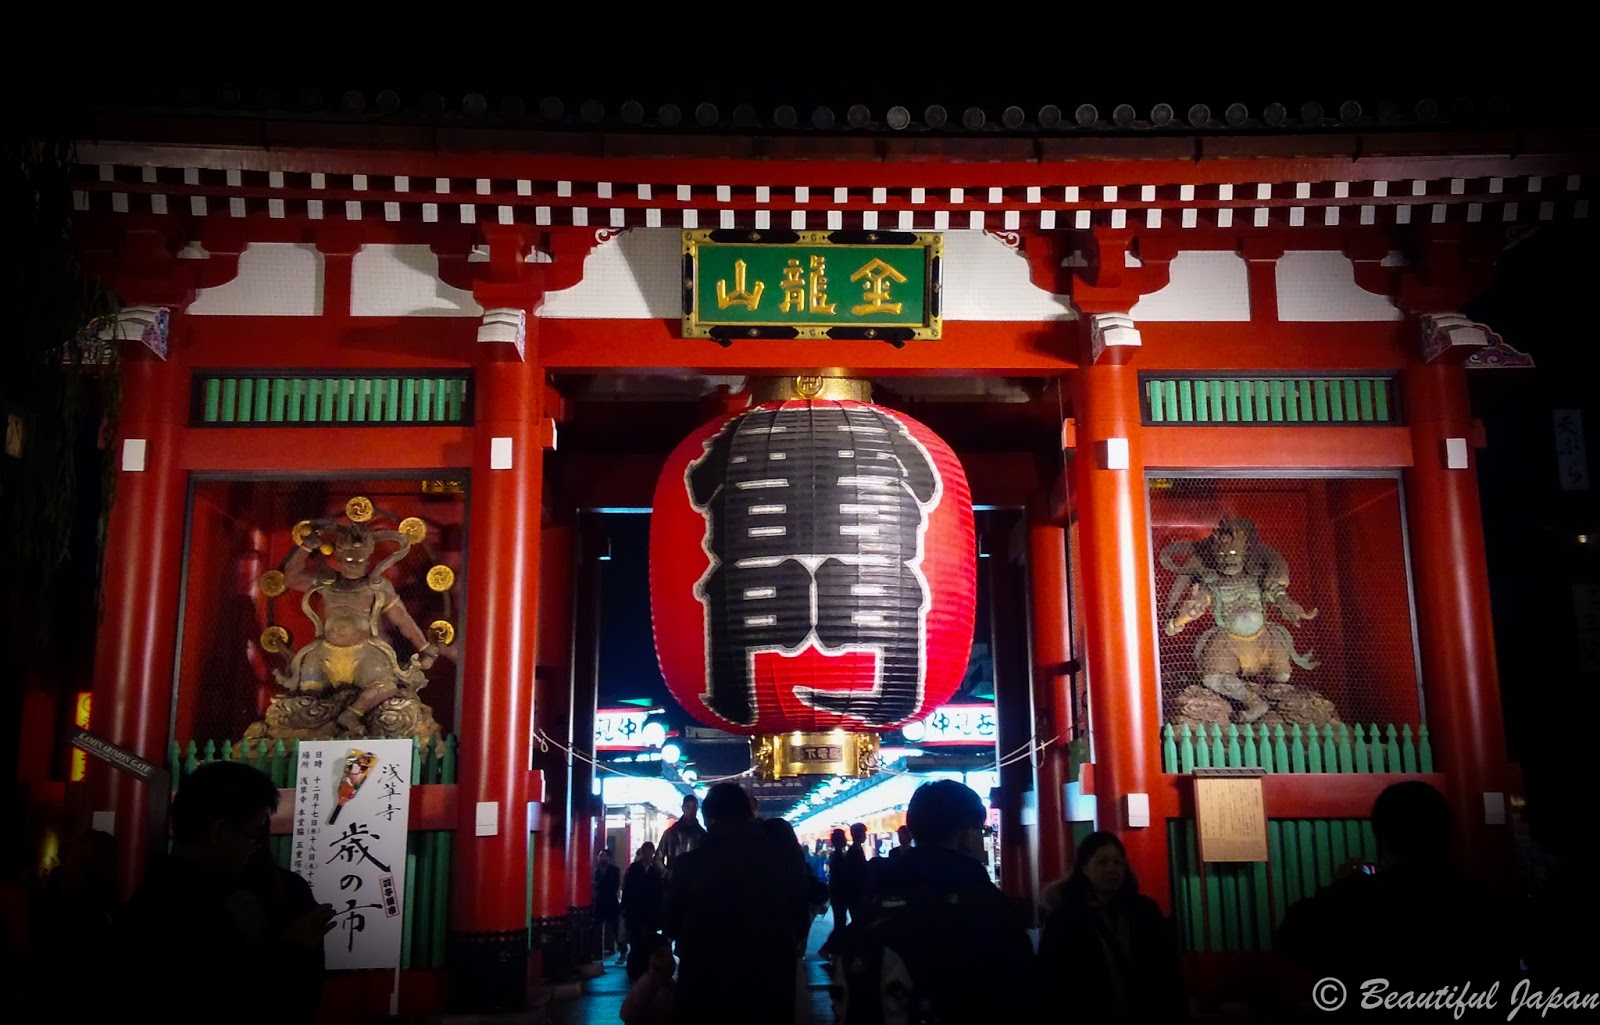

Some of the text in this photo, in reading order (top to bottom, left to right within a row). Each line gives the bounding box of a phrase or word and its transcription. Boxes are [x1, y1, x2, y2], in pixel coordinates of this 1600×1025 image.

[685, 405, 944, 729] 雷門
[78, 732, 130, 763] KAMINARIMON
[129, 758, 152, 774] GATE
[313, 750, 323, 769] 日時
[375, 762, 404, 822] 浅草寺
[325, 821, 391, 953] 歳の市
